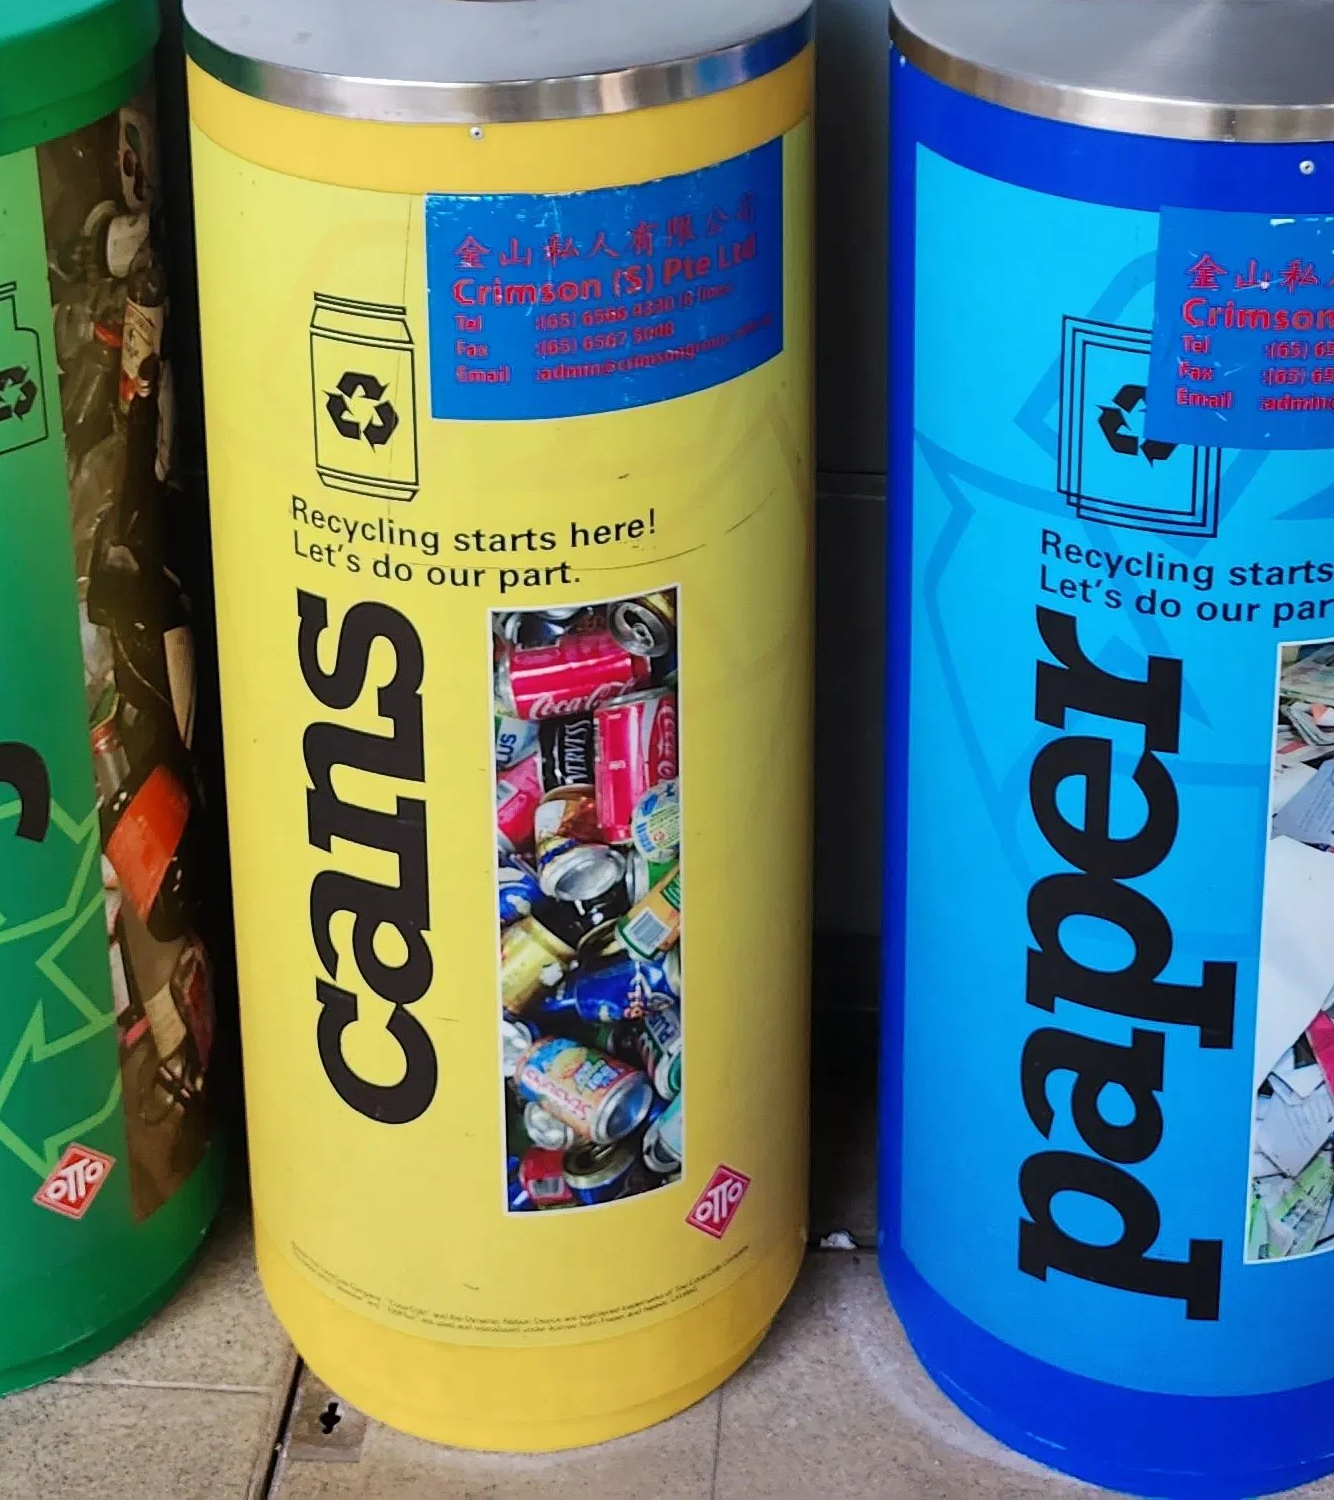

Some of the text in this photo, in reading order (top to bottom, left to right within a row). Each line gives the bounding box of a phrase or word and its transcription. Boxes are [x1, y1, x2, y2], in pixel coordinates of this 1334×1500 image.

[453, 276, 601, 307] Crimson
[613, 263, 654, 297] (S)
[662, 255, 711, 285] Pte
[454, 314, 482, 332] Tel
[1181, 334, 1211, 354] Tel
[1176, 386, 1233, 410] Email
[291, 494, 657, 555] Recycling starts here!
[292, 529, 581, 593] Let's do our part.
[1041, 528, 1214, 591] Recycling
[1228, 559, 1334, 586] starts
[1040, 563, 1123, 610] Let's
[1135, 588, 1181, 618] do
[1196, 599, 1260, 623] our
[296, 587, 439, 1125] cans
[1018, 604, 1238, 1322] paper
[44, 1157, 105, 1205] OTTO
[693, 1176, 743, 1224] OTTO
